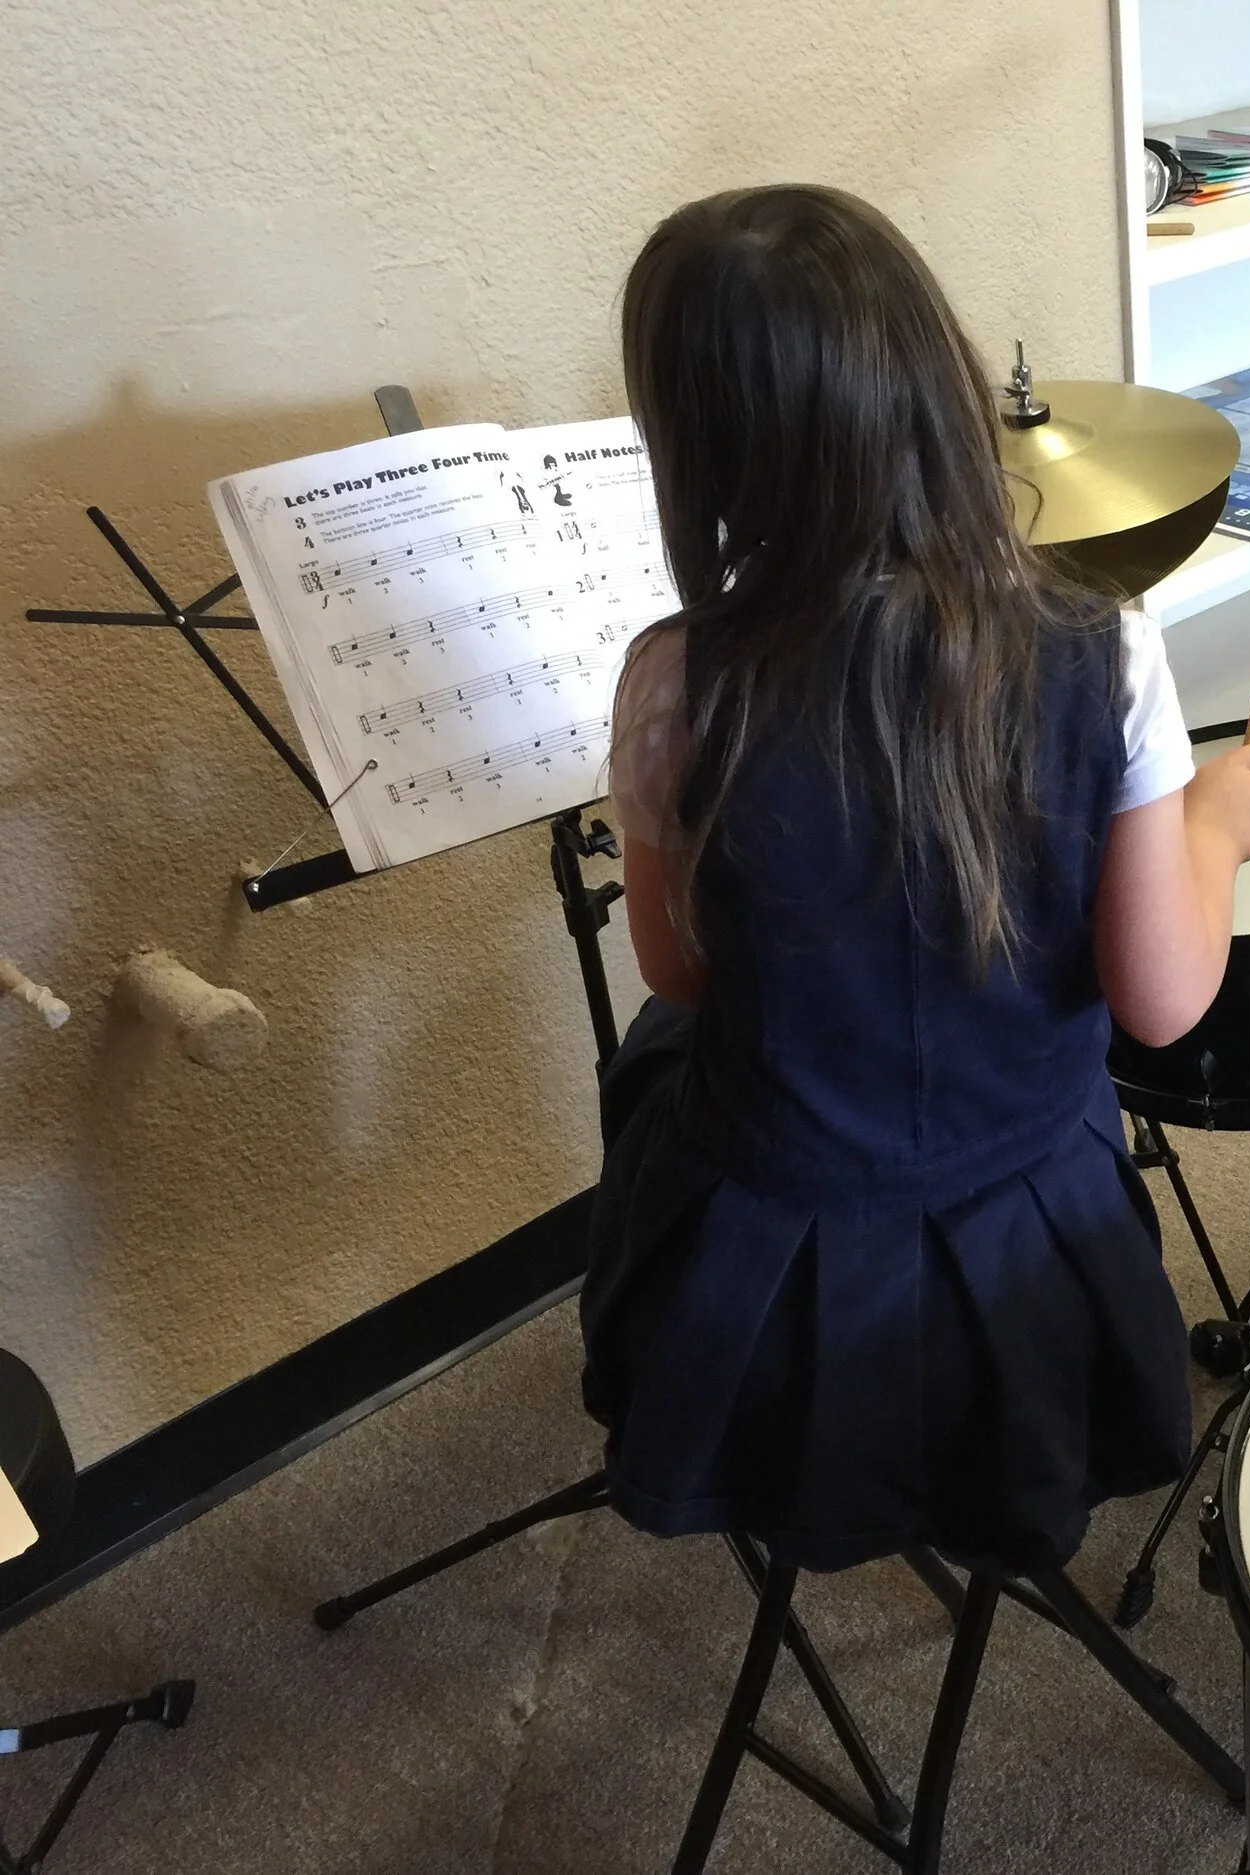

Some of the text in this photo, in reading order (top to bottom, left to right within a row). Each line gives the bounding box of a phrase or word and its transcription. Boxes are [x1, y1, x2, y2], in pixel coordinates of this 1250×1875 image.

[565, 445, 644, 462] Half Notes
[284, 488, 330, 508] Let's
[333, 476, 372, 495] Play
[375, 463, 428, 484] Three
[432, 455, 471, 470] Four
[473, 450, 510, 463] Time
[295, 516, 306, 530] 3
[304, 536, 315, 549] 4
[299, 560, 319, 569] Largo
[339, 587, 356, 596] walk
[374, 577, 392, 586] walk
[410, 568, 427, 576] walk
[576, 581, 586, 593] 2
[355, 660, 372, 669] walk
[393, 648, 410, 658] walk
[432, 638, 445, 646] rest
[480, 622, 497, 631] walk
[596, 632, 606, 644] 3
[383, 728, 400, 737] walk
[422, 717, 435, 726] rest
[460, 705, 472, 714] rest
[510, 689, 523, 698] rest
[544, 678, 560, 686] walk
[412, 745, 588, 806] walk rest walk walk walk
